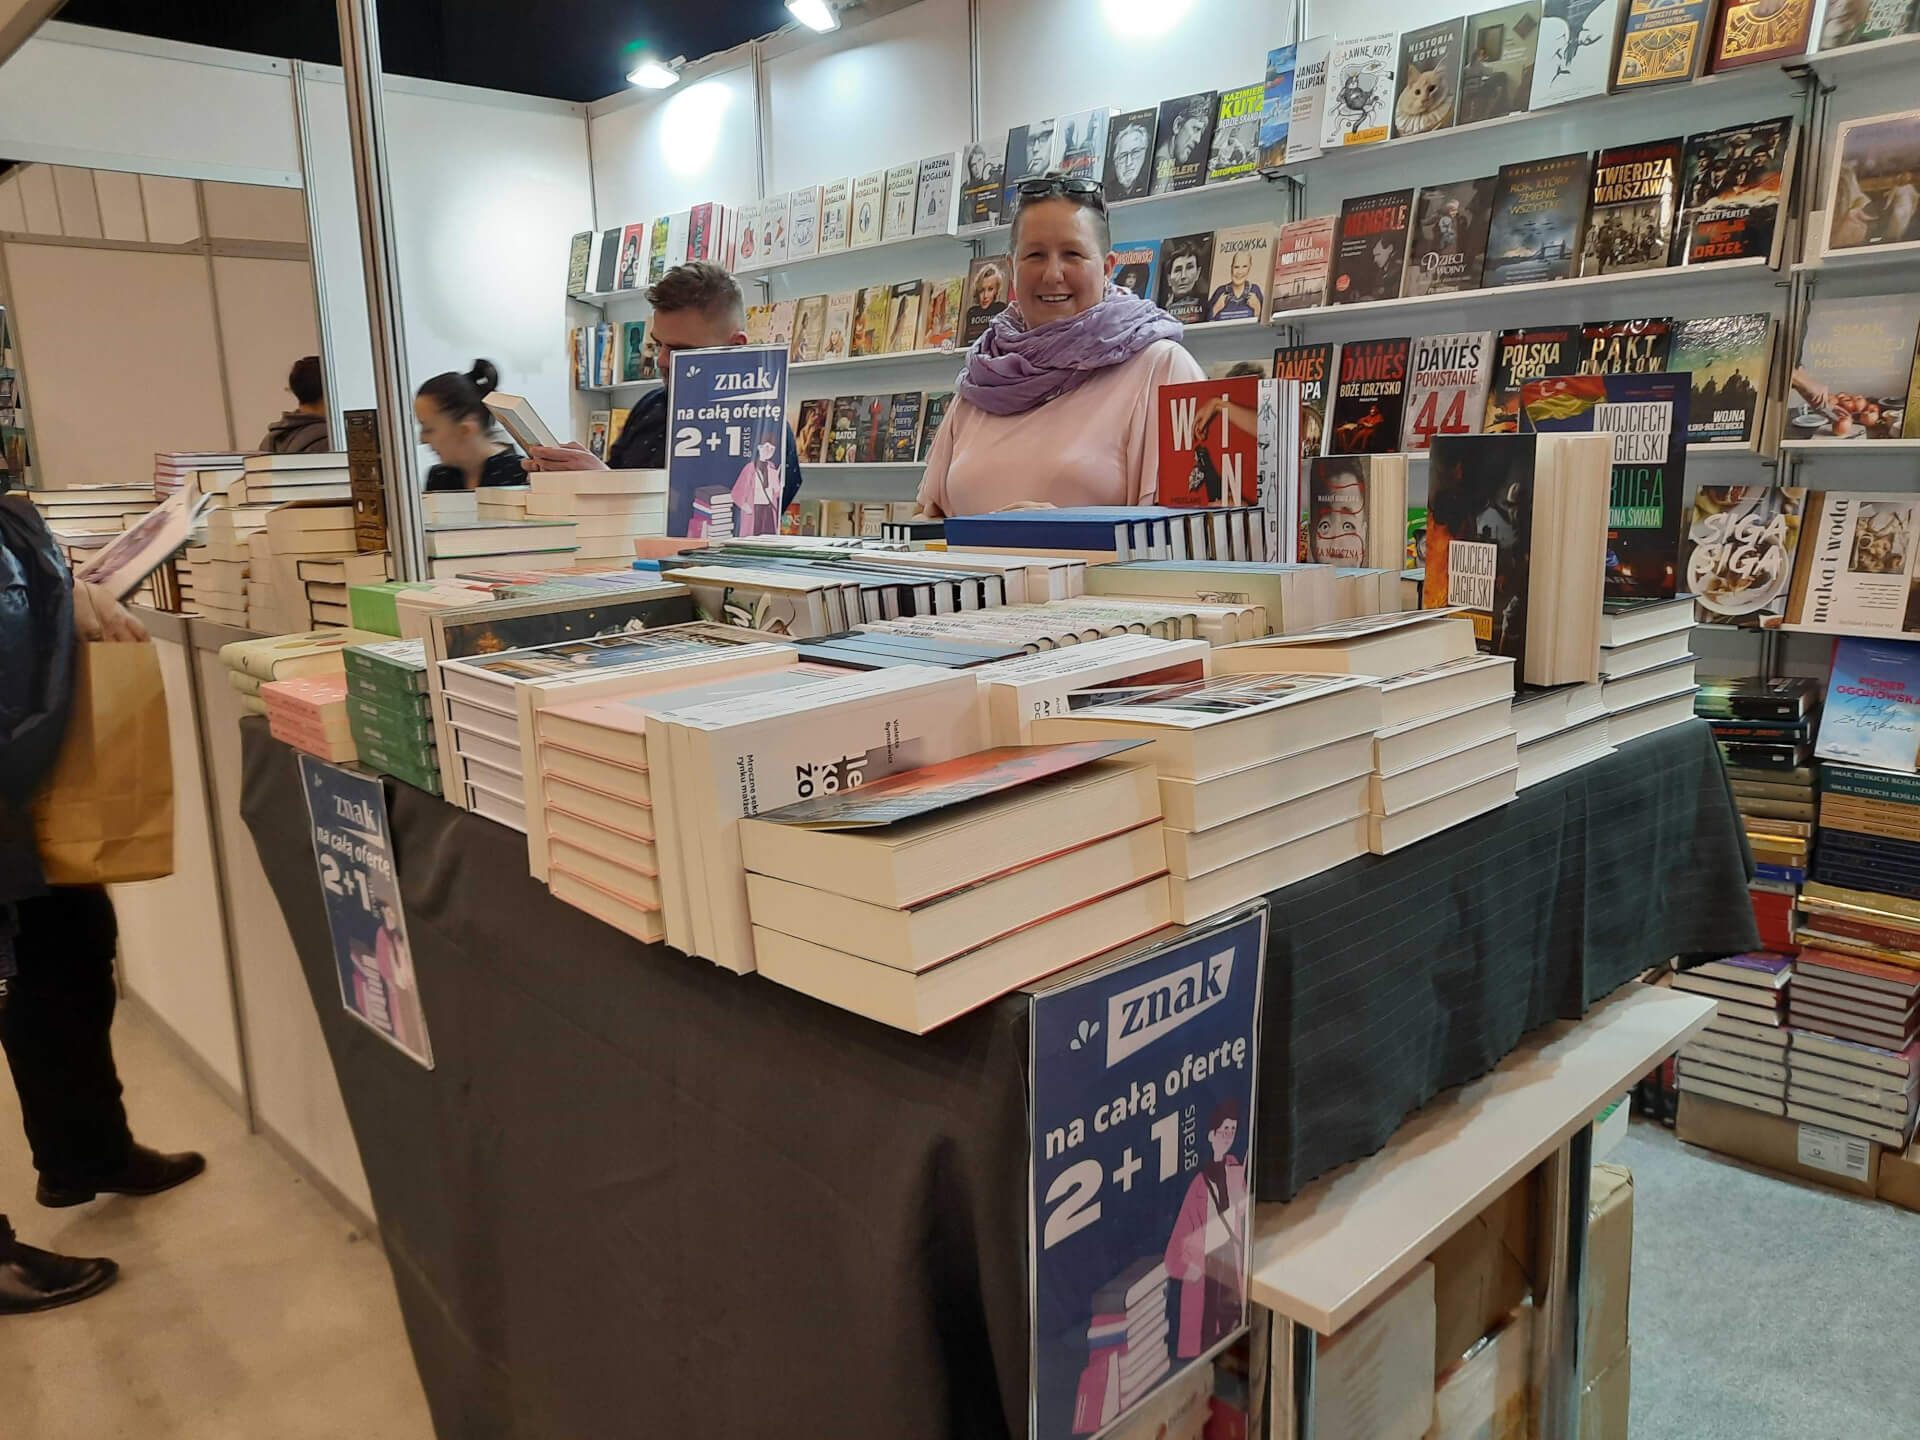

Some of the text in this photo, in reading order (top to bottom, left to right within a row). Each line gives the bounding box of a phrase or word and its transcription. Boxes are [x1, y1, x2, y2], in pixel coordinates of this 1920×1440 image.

[1373, 43, 1393, 58] KOTY
[1408, 33, 1454, 53] HISTORIA
[1296, 61, 1326, 78] JANUSZ
[1223, 86, 1264, 102] KAZIMIER
[1295, 74, 1327, 91] FILIPIAK
[1220, 95, 1264, 119] KUTZ
[1156, 163, 1200, 179] ENGLERT
[1596, 158, 1673, 187] TWIERDZA
[1344, 204, 1408, 239] MENGELE
[1697, 211, 1720, 224] JERZY
[1220, 239, 1268, 253] DZIKOWSKA
[1694, 240, 1744, 258] ORZEŁ
[1421, 251, 1465, 274] DZIECI
[1436, 264, 1467, 276] WOJNY
[971, 314, 993, 325] BOGIN
[1420, 336, 1483, 348] NORMAN
[1591, 335, 1657, 361] PAKT
[1417, 345, 1481, 371] DAVIES
[1502, 342, 1560, 367] POLSKA
[1579, 353, 1663, 376] DIABŁÓW
[714, 367, 773, 391] znak
[1275, 358, 1325, 382] DAVIES
[1342, 353, 1406, 384] DAVIES
[1415, 369, 1478, 387] POWSTANIE
[1340, 381, 1402, 398] BOŻE IGRZYSKO
[677, 403, 781, 424] na całą ofertę
[1600, 404, 1667, 433] WOJCIECH
[1713, 409, 1746, 423] WOJNA
[743, 427, 751, 458] gratis
[1614, 433, 1664, 462] GIELSKI
[1611, 468, 1664, 507] RUGA
[1627, 506, 1660, 527] ŚWIATA
[1826, 499, 1850, 551] woda
[1698, 511, 1788, 549] SIGA
[1451, 543, 1494, 577] WOJCIECH
[1695, 542, 1783, 581] SIGA
[1450, 575, 1492, 609] JAGIELSKI
[737, 756, 750, 785] rynku
[747, 754, 759, 794] Mroczne
[333, 794, 377, 832] znak
[317, 825, 392, 882] na całą ofertę
[1119, 962, 1223, 1040] znak
[1045, 1037, 1246, 1160] na całą ofertę
[1181, 1104, 1199, 1172] gratis
